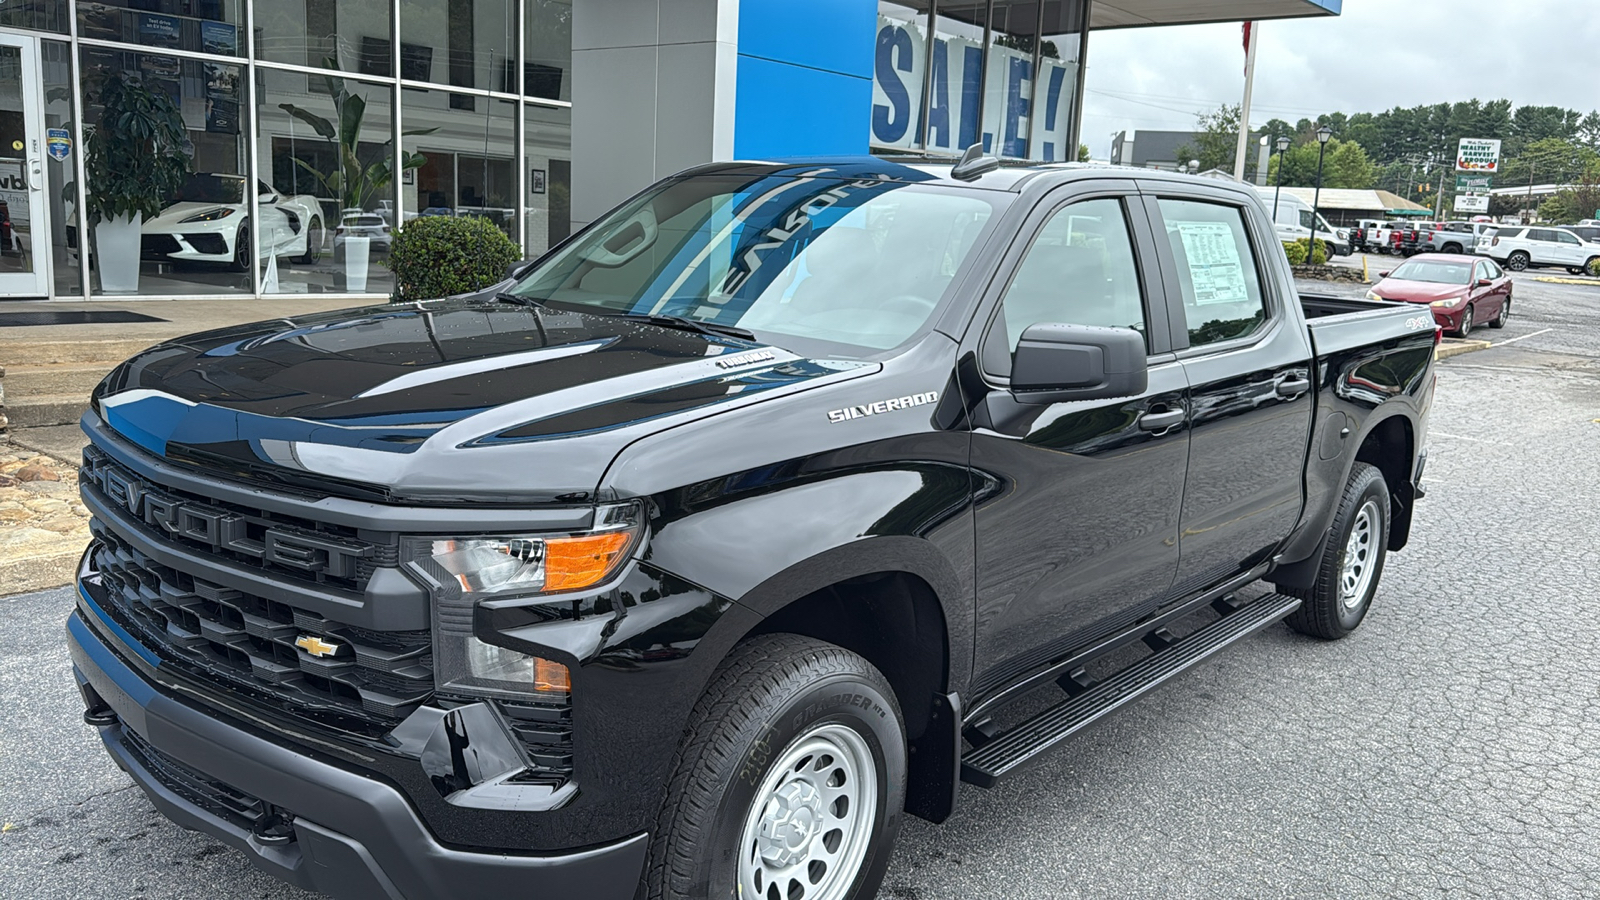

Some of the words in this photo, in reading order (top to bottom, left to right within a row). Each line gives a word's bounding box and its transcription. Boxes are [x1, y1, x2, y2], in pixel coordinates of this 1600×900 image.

[872, 25, 1066, 161] SALE!
[715, 351, 775, 370] TURBOMAX
[827, 391, 939, 424] SILVERADO
[792, 693, 873, 731] GRABBER
